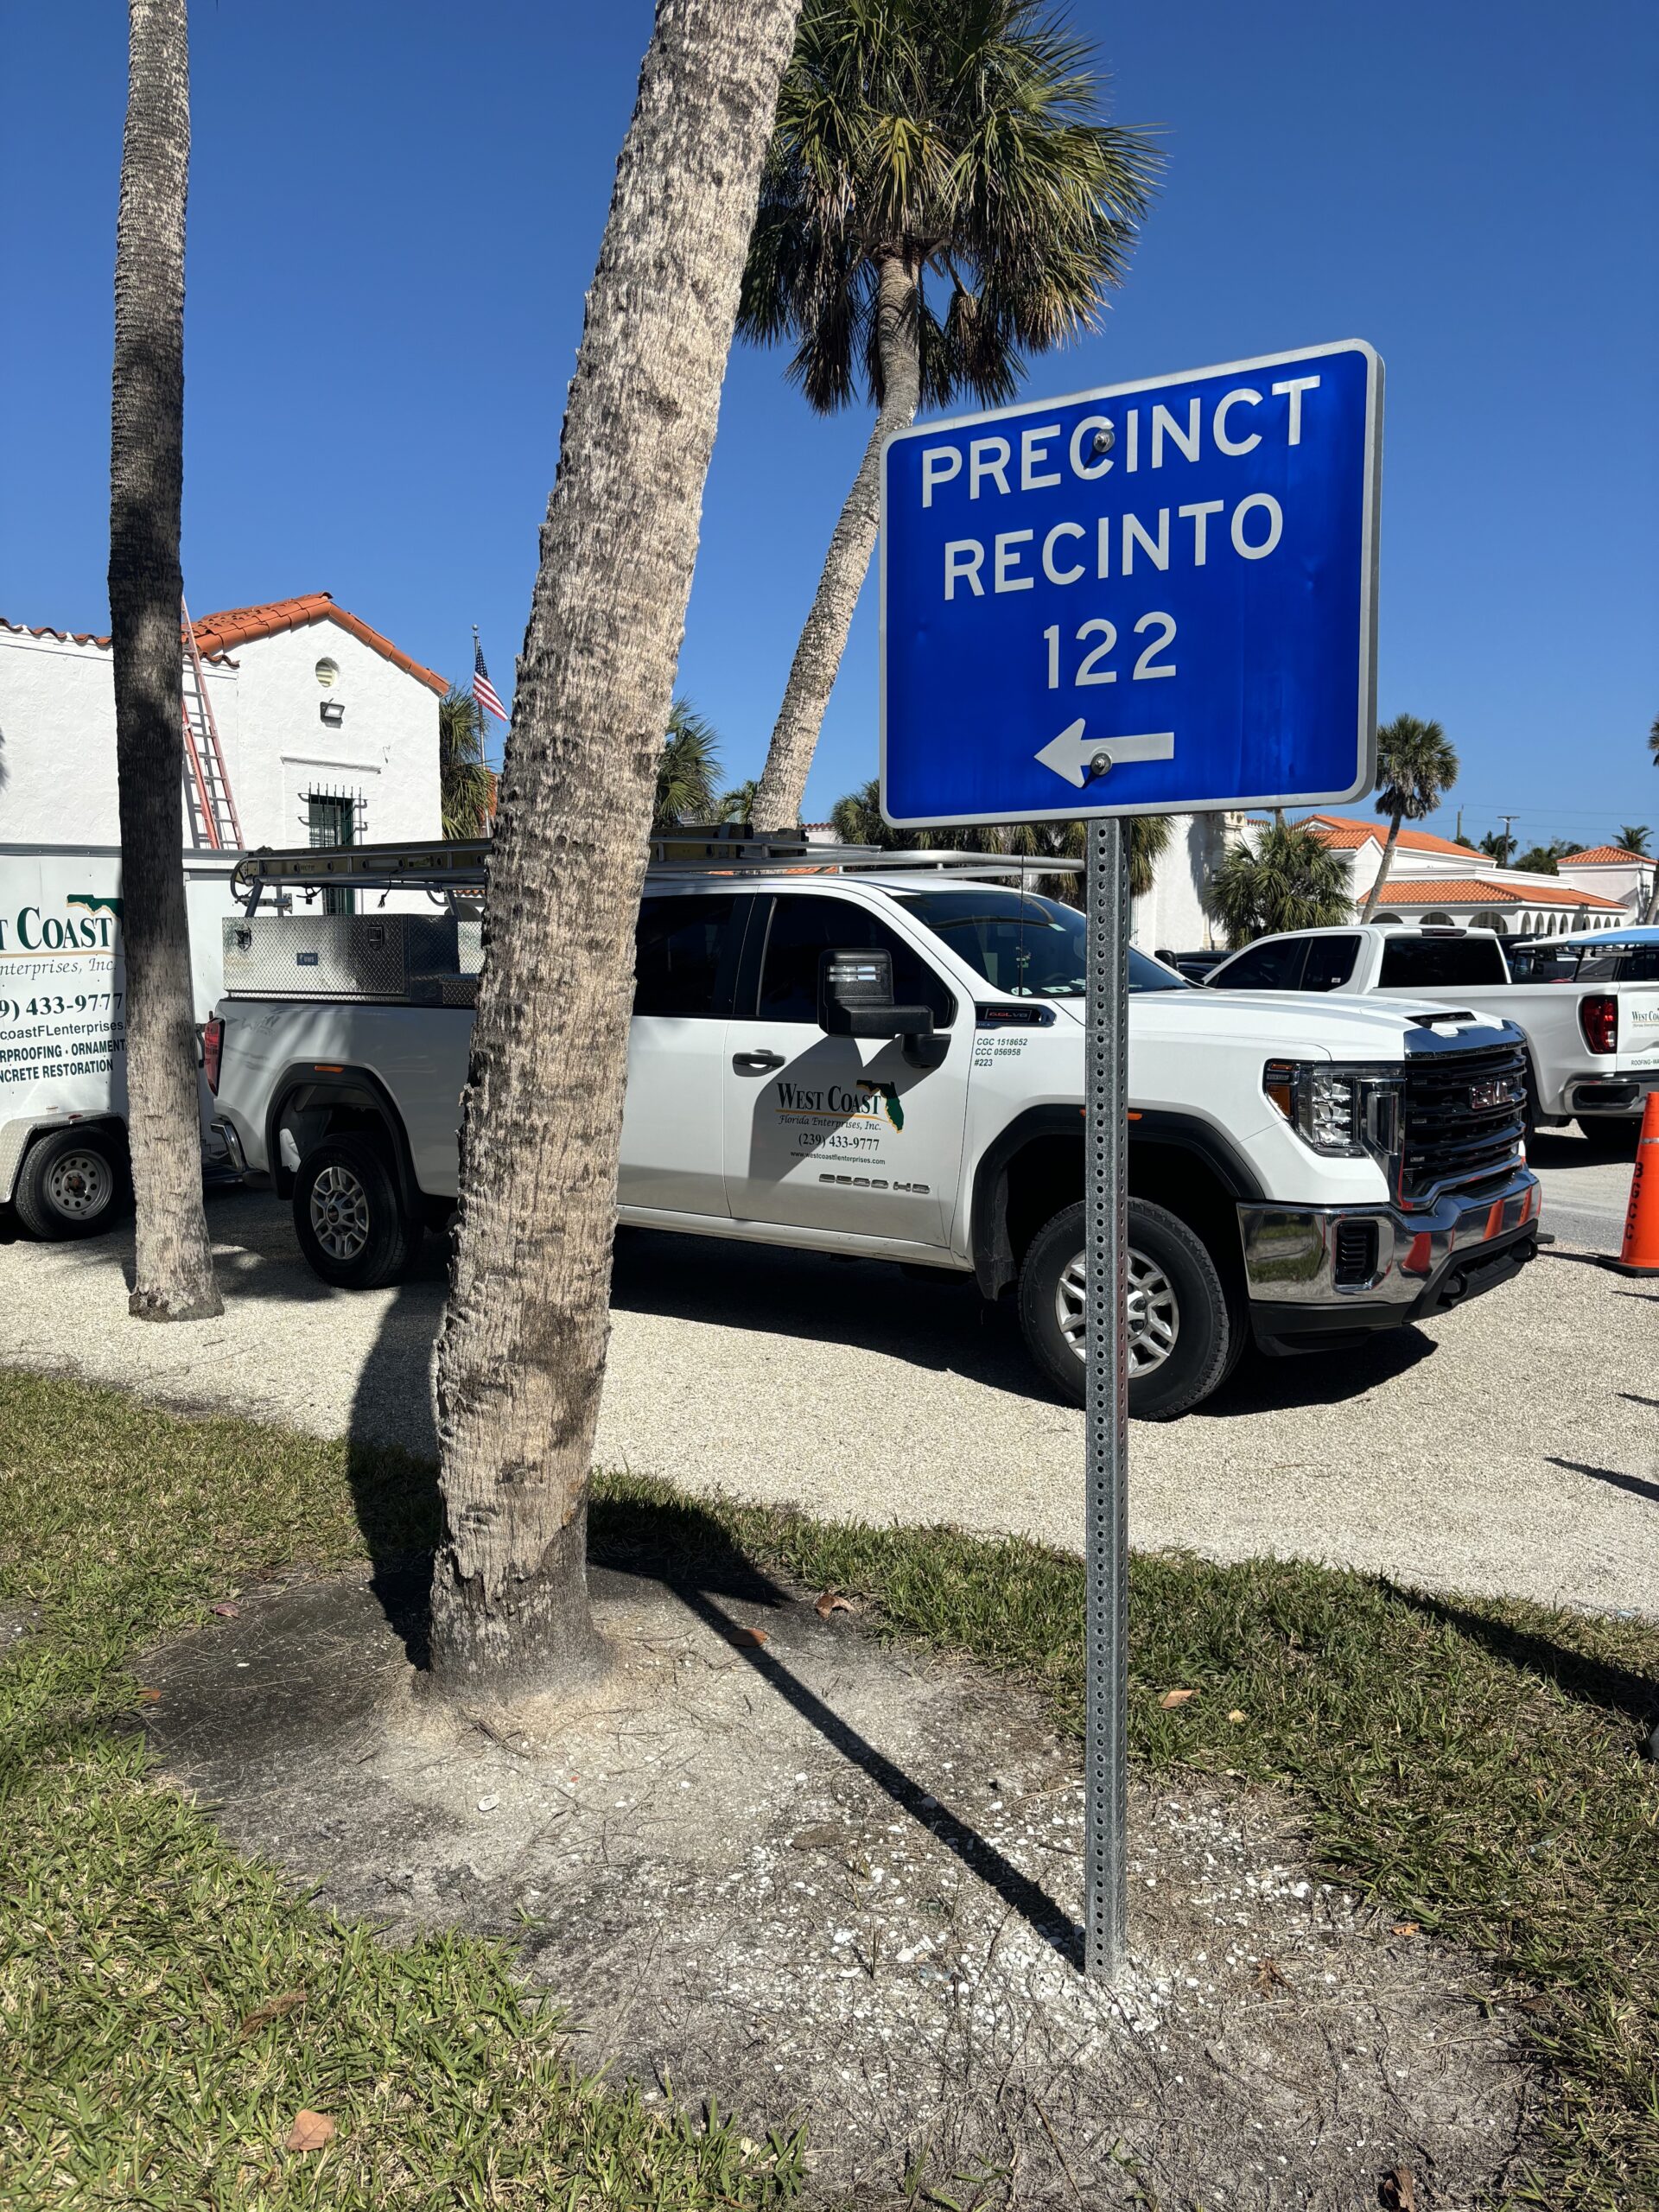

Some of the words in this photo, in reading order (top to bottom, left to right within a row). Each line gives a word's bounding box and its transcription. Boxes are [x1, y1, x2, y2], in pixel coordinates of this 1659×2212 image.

[922, 375, 1320, 508] PRECINCT
[944, 493, 1283, 601] RECINTO
[1043, 611, 1177, 690] 122
[89, 957, 117, 972] Inc.
[26, 993, 123, 1016] 433-9777
[71, 1039, 127, 1056] ORNAMENT
[42, 1059, 113, 1078] RESTORATION
[974, 1058, 993, 1067] #223
[779, 1115, 810, 1125] Florida
[865, 1121, 881, 1131] Inc.
[798, 1133, 826, 1148] (239)
[829, 1135, 880, 1151] 433-9777
[790, 1150, 886, 1165] www.westcoastflenterprises.com
